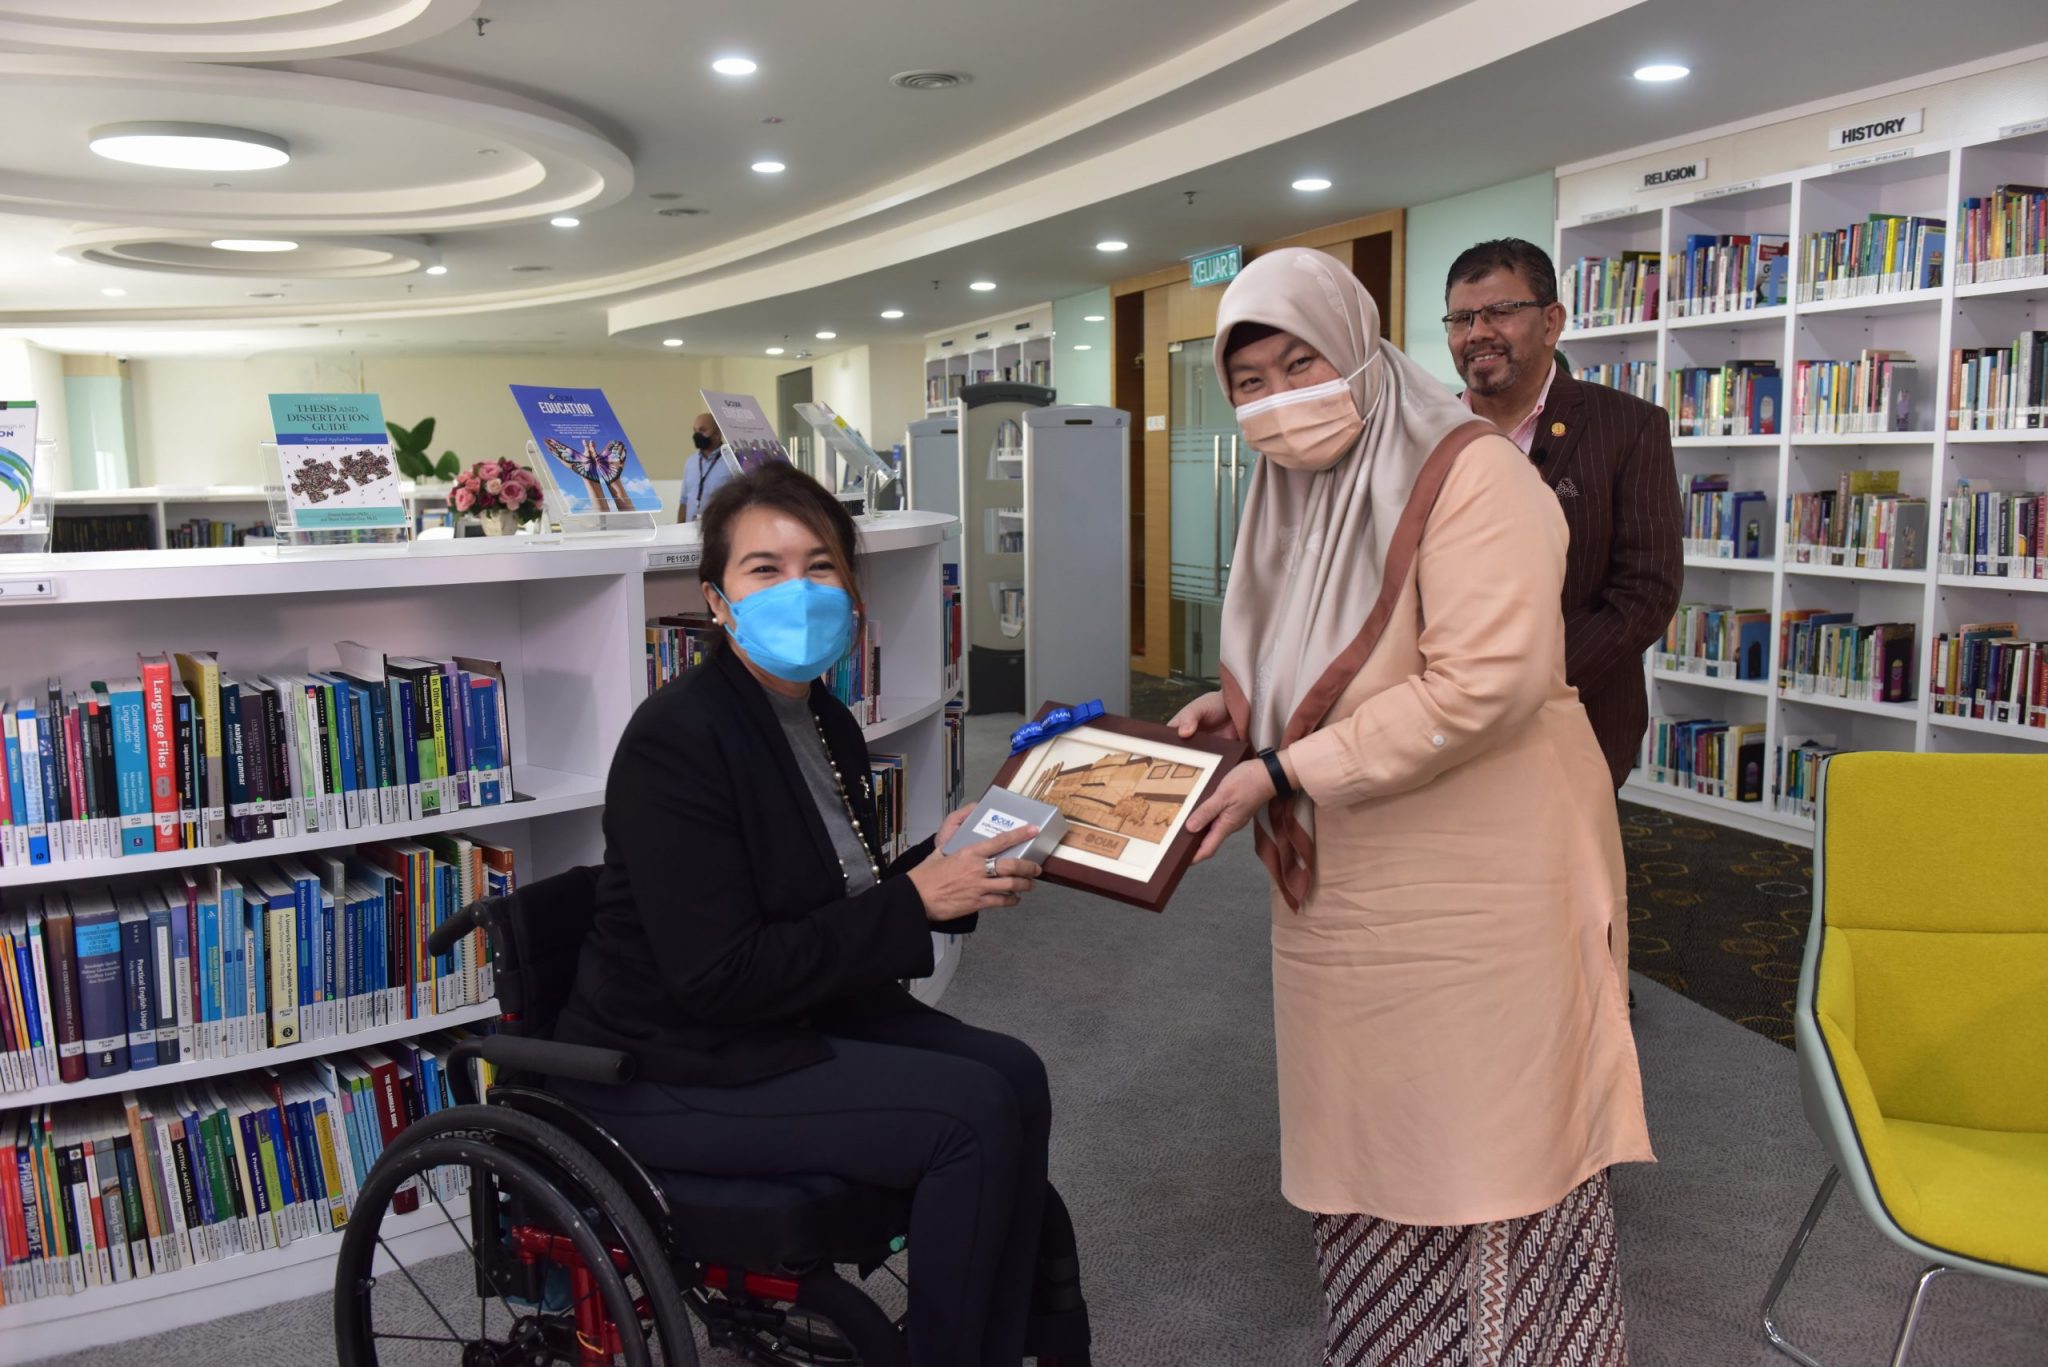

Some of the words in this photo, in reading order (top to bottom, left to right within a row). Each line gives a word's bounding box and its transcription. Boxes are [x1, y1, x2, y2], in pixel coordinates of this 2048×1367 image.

[1842, 117, 1906, 144] HISTORY
[1644, 165, 1697, 187] RELIGION
[287, 413, 370, 422] DISSERTATION
[295, 404, 337, 413] THESIS
[538, 401, 594, 415] EDUCATION
[312, 422, 350, 431] GUIDE
[432, 678, 440, 686] In
[152, 680, 165, 738] Language
[433, 688, 441, 707] Other
[121, 705, 132, 743] Linguistics
[130, 704, 141, 754] Contemporary
[377, 718, 385, 749] PERSUASION
[434, 710, 443, 732] Words
[234, 723, 243, 754] Analyzing
[158, 741, 168, 768] Files
[237, 755, 246, 785] Grammar
[136, 959, 146, 986] Practical
[179, 966, 187, 987] History
[138, 987, 147, 1009] English
[181, 995, 189, 1016] English
[140, 1010, 148, 1030] Usage
[385, 1085, 395, 1113] GRAMMAR
[18, 1162, 36, 1204] PYRAMID
[168, 1168, 178, 1200] Thoughtful
[177, 1142, 185, 1171] WRITING
[182, 1172, 192, 1203] MATERIAL
[252, 1157, 262, 1185] Practicum
[257, 1192, 266, 1210] TESOL
[109, 1196, 120, 1225] Reading
[25, 1206, 41, 1251] PRINCIPLE
